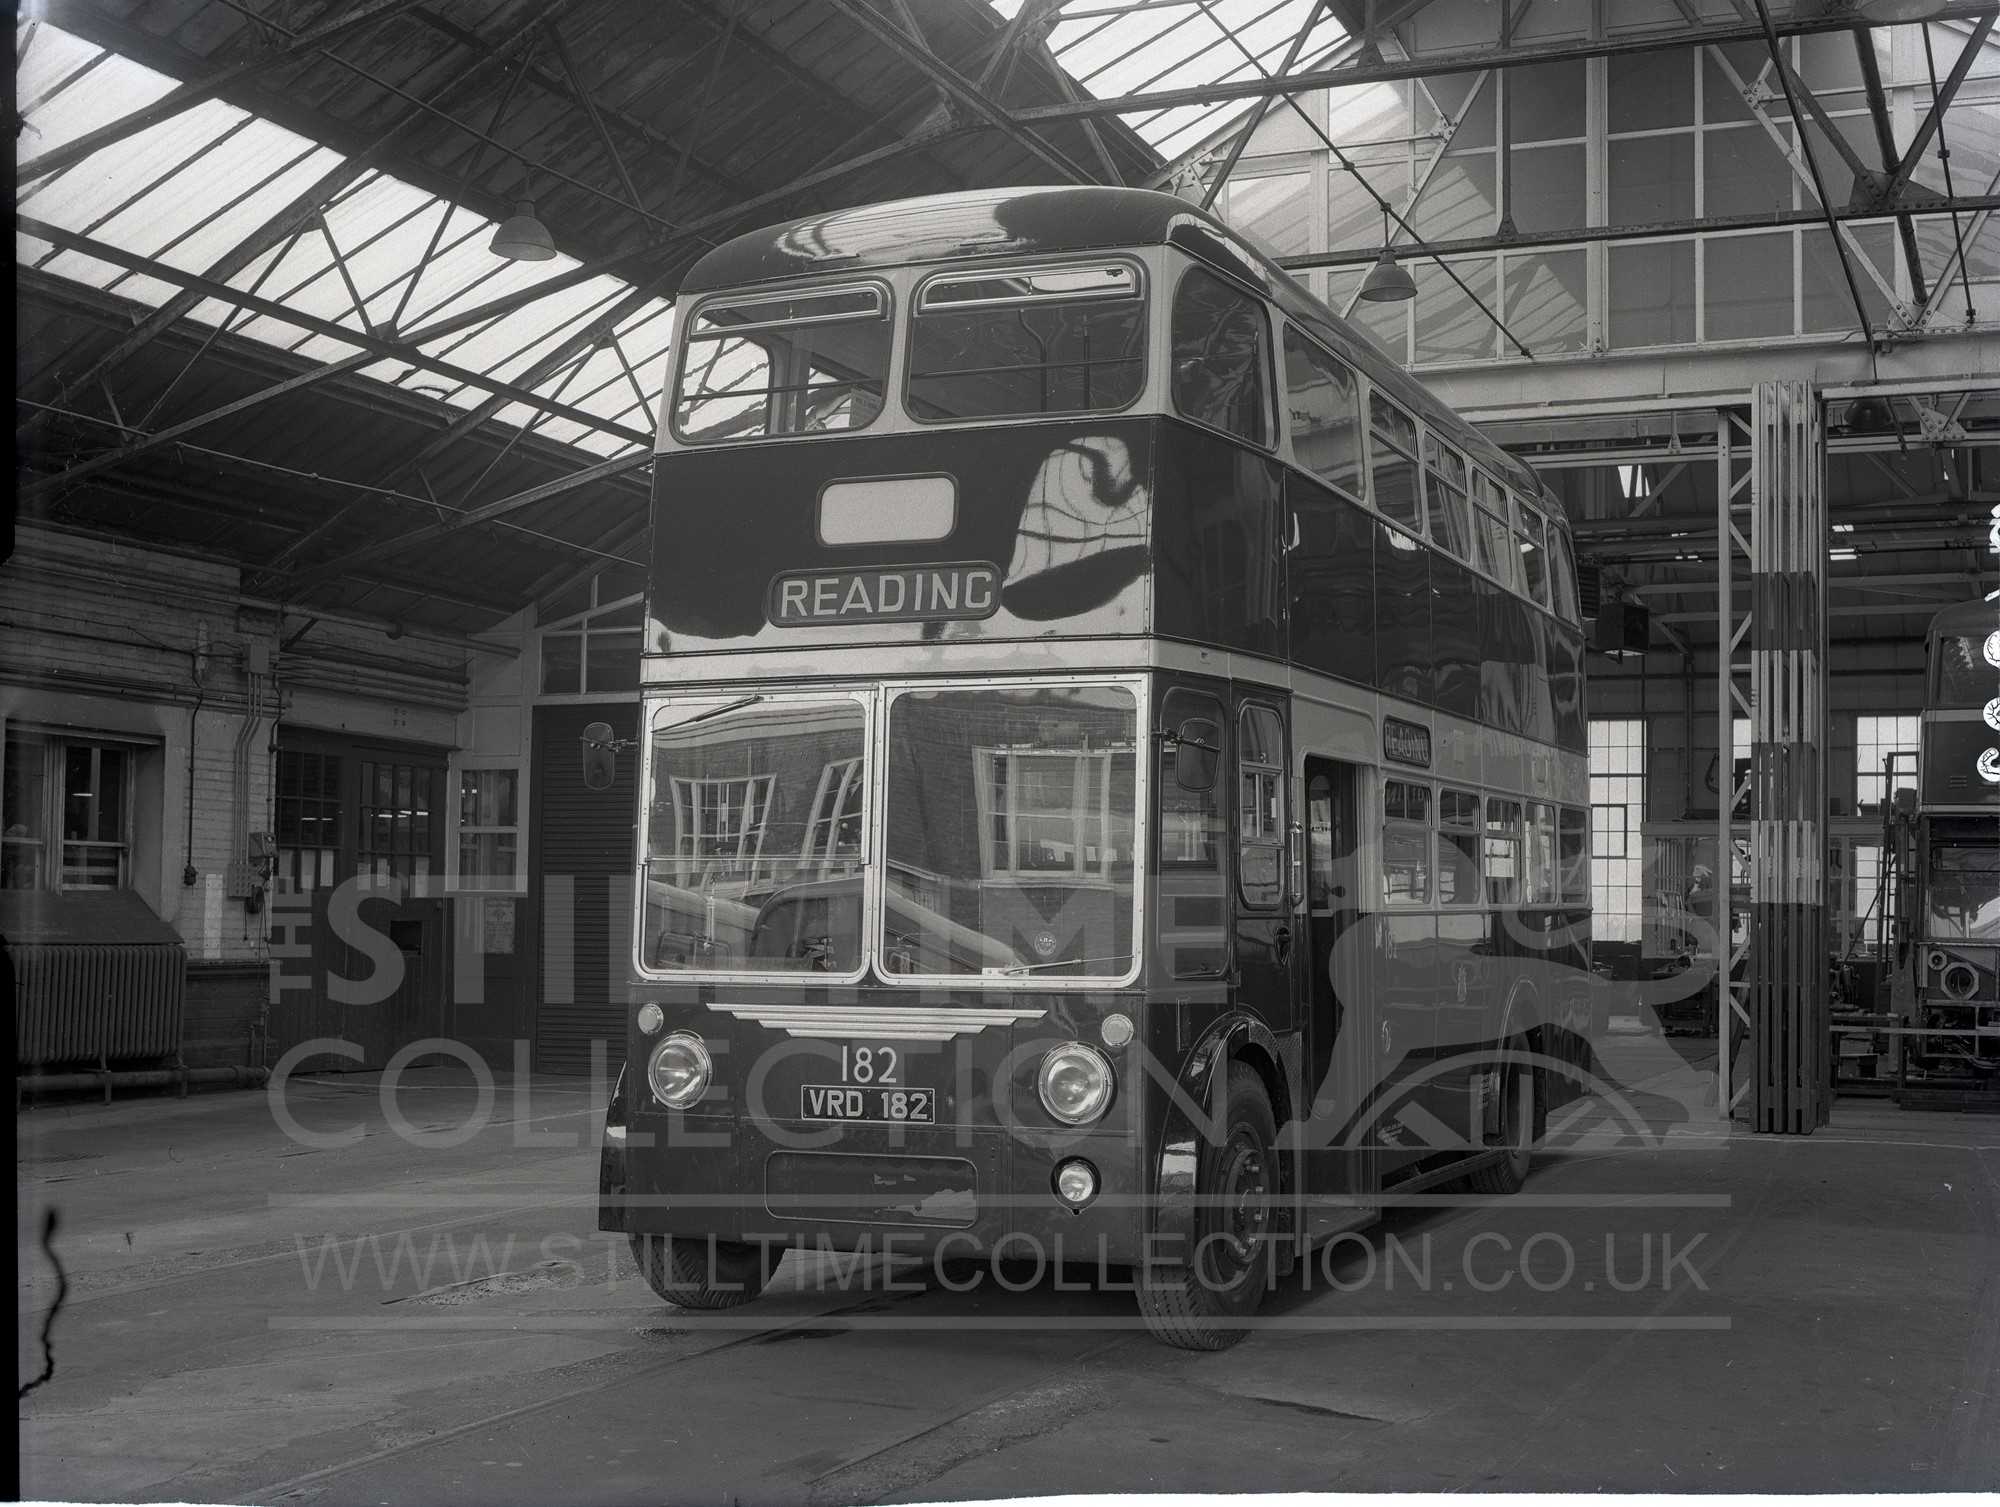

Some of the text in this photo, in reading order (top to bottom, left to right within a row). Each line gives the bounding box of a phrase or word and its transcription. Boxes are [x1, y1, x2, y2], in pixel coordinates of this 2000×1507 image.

[781, 571, 992, 617] READING
[842, 1045, 897, 1083] 182
[809, 1089, 928, 1120] VRD 182
